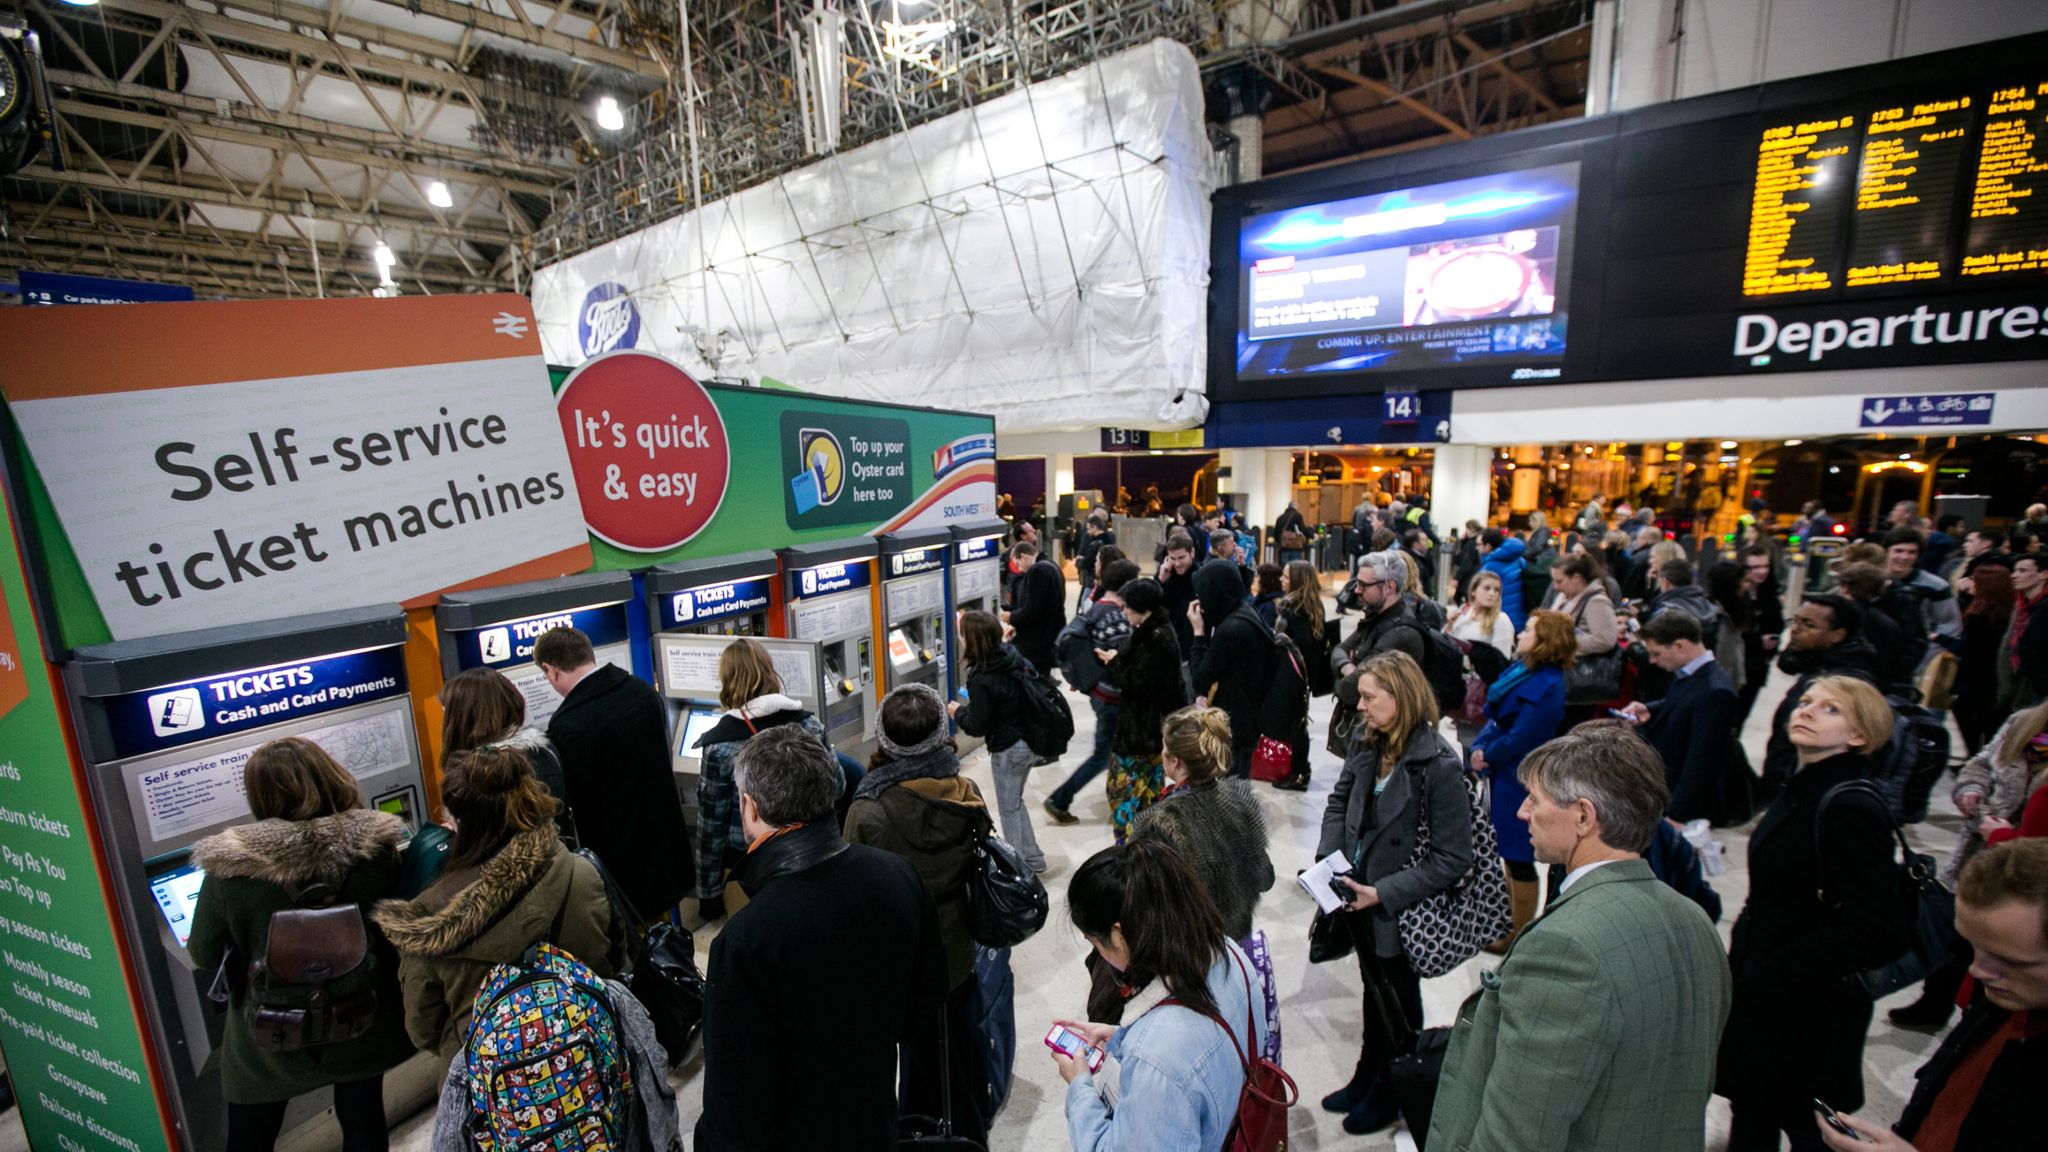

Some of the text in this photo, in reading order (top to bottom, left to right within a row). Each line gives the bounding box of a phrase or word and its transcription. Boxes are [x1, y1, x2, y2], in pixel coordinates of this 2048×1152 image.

[1913, 100, 1959, 116] Platform
[1988, 98, 2035, 115] Dorking
[1983, 136, 2020, 147] Clapham
[586, 298, 632, 352] Boots
[1317, 334, 1362, 349] COMING
[1388, 325, 1492, 343] ENTERTAINMENT
[1386, 396, 1412, 418] 14
[574, 408, 710, 459] It's quick
[850, 436, 904, 457] Top up your
[1110, 428, 1126, 445] 13
[154, 406, 507, 502] Self-service
[603, 463, 697, 506] & easy
[852, 461, 904, 481] Oyster card
[853, 486, 893, 502] here too
[944, 503, 979, 518] SOUTH WEST
[115, 471, 565, 607] ticket machines
[816, 564, 845, 580] TICKETS
[818, 578, 850, 591] Card Payments
[695, 585, 735, 604] TICKETS
[697, 596, 767, 618] Cash and Card Payments
[209, 665, 314, 702] TICKETS
[216, 676, 396, 725] Cash and Card Payments
[144, 753, 249, 786] Self service train
[28, 810, 71, 838] tickets
[1, 845, 67, 881] Pay As You
[11, 876, 52, 910] Top up
[11, 920, 92, 959] season tickets
[4, 950, 91, 999] Monthly season
[13, 981, 99, 1029] ticket renewals
[0, 1008, 141, 1085] Pre-paid ticket collection
[48, 1064, 108, 1105] Groupsave
[39, 1092, 141, 1152] Railcard discounts
